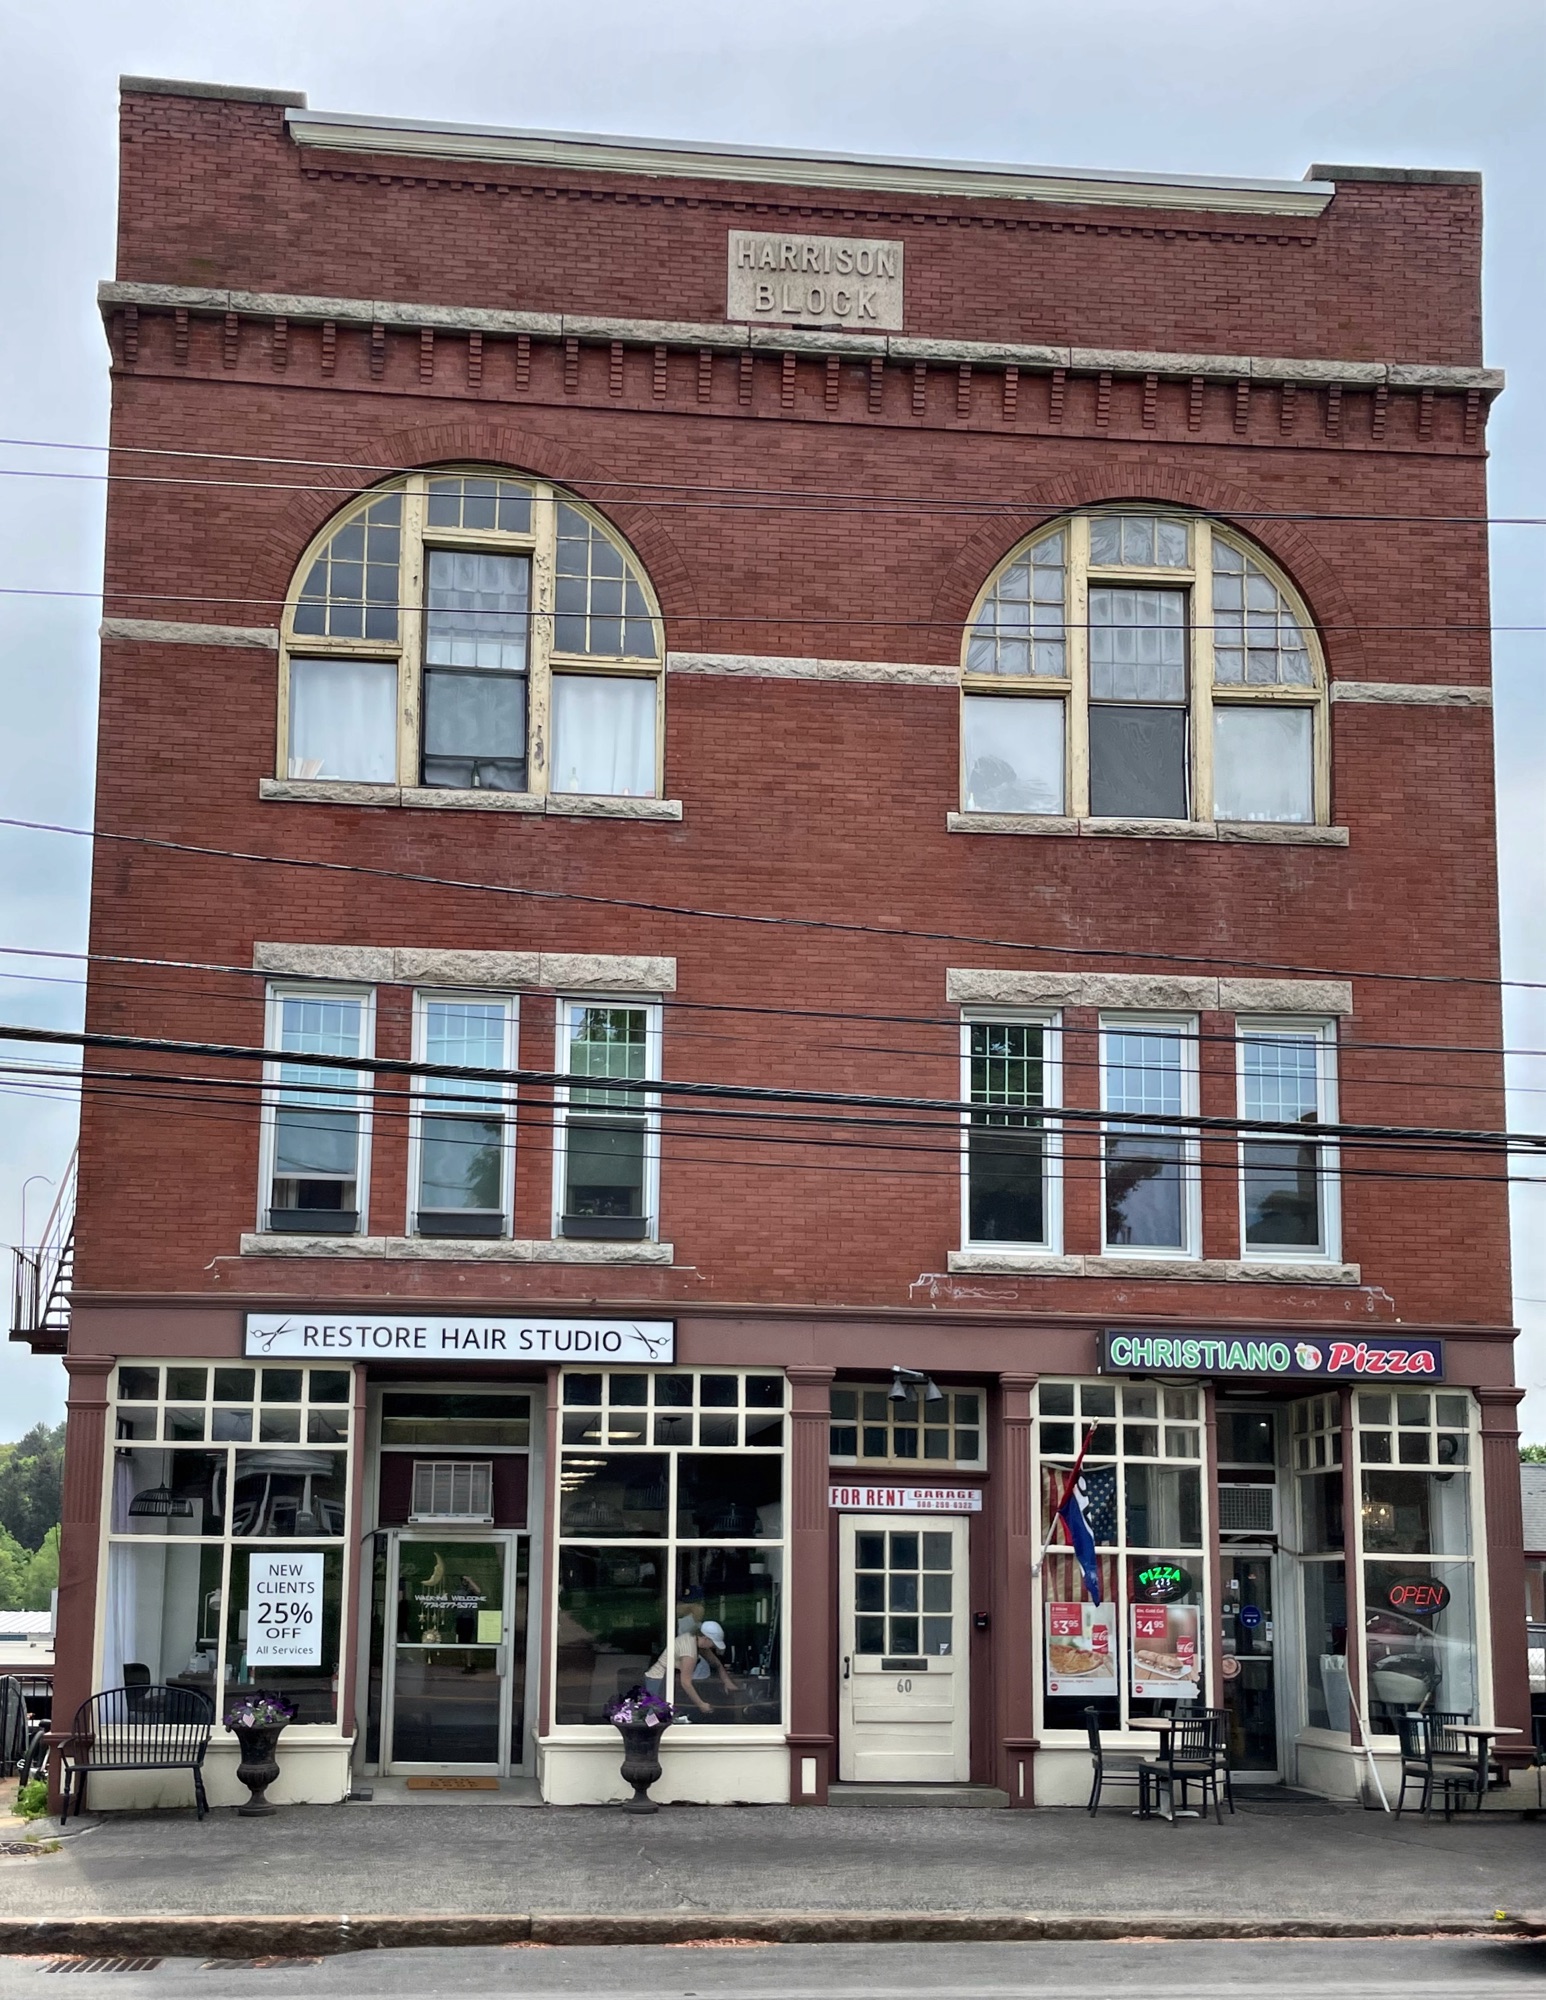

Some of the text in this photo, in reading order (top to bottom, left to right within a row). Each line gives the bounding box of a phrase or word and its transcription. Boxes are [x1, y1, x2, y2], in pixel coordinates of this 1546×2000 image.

[737, 239, 895, 278] HARRISON
[755, 283, 877, 319] BLOCK
[303, 1325, 623, 1352] RESTORE HAIR STUDIO
[1111, 1337, 1435, 1373] CHRISTIANO Pizza
[832, 1488, 905, 1506] FOR RENT
[914, 1490, 975, 1499] GARAGE
[269, 1564, 303, 1576] NEW
[1139, 1567, 1181, 1585] PIZZA
[257, 1582, 315, 1594] CLIENTS
[1390, 1585, 1444, 1605] OPEN
[257, 1602, 313, 1624] 25%
[266, 1627, 301, 1639] OFF
[256, 1645, 313, 1655] All Services
[897, 1679, 912, 1693] 60
